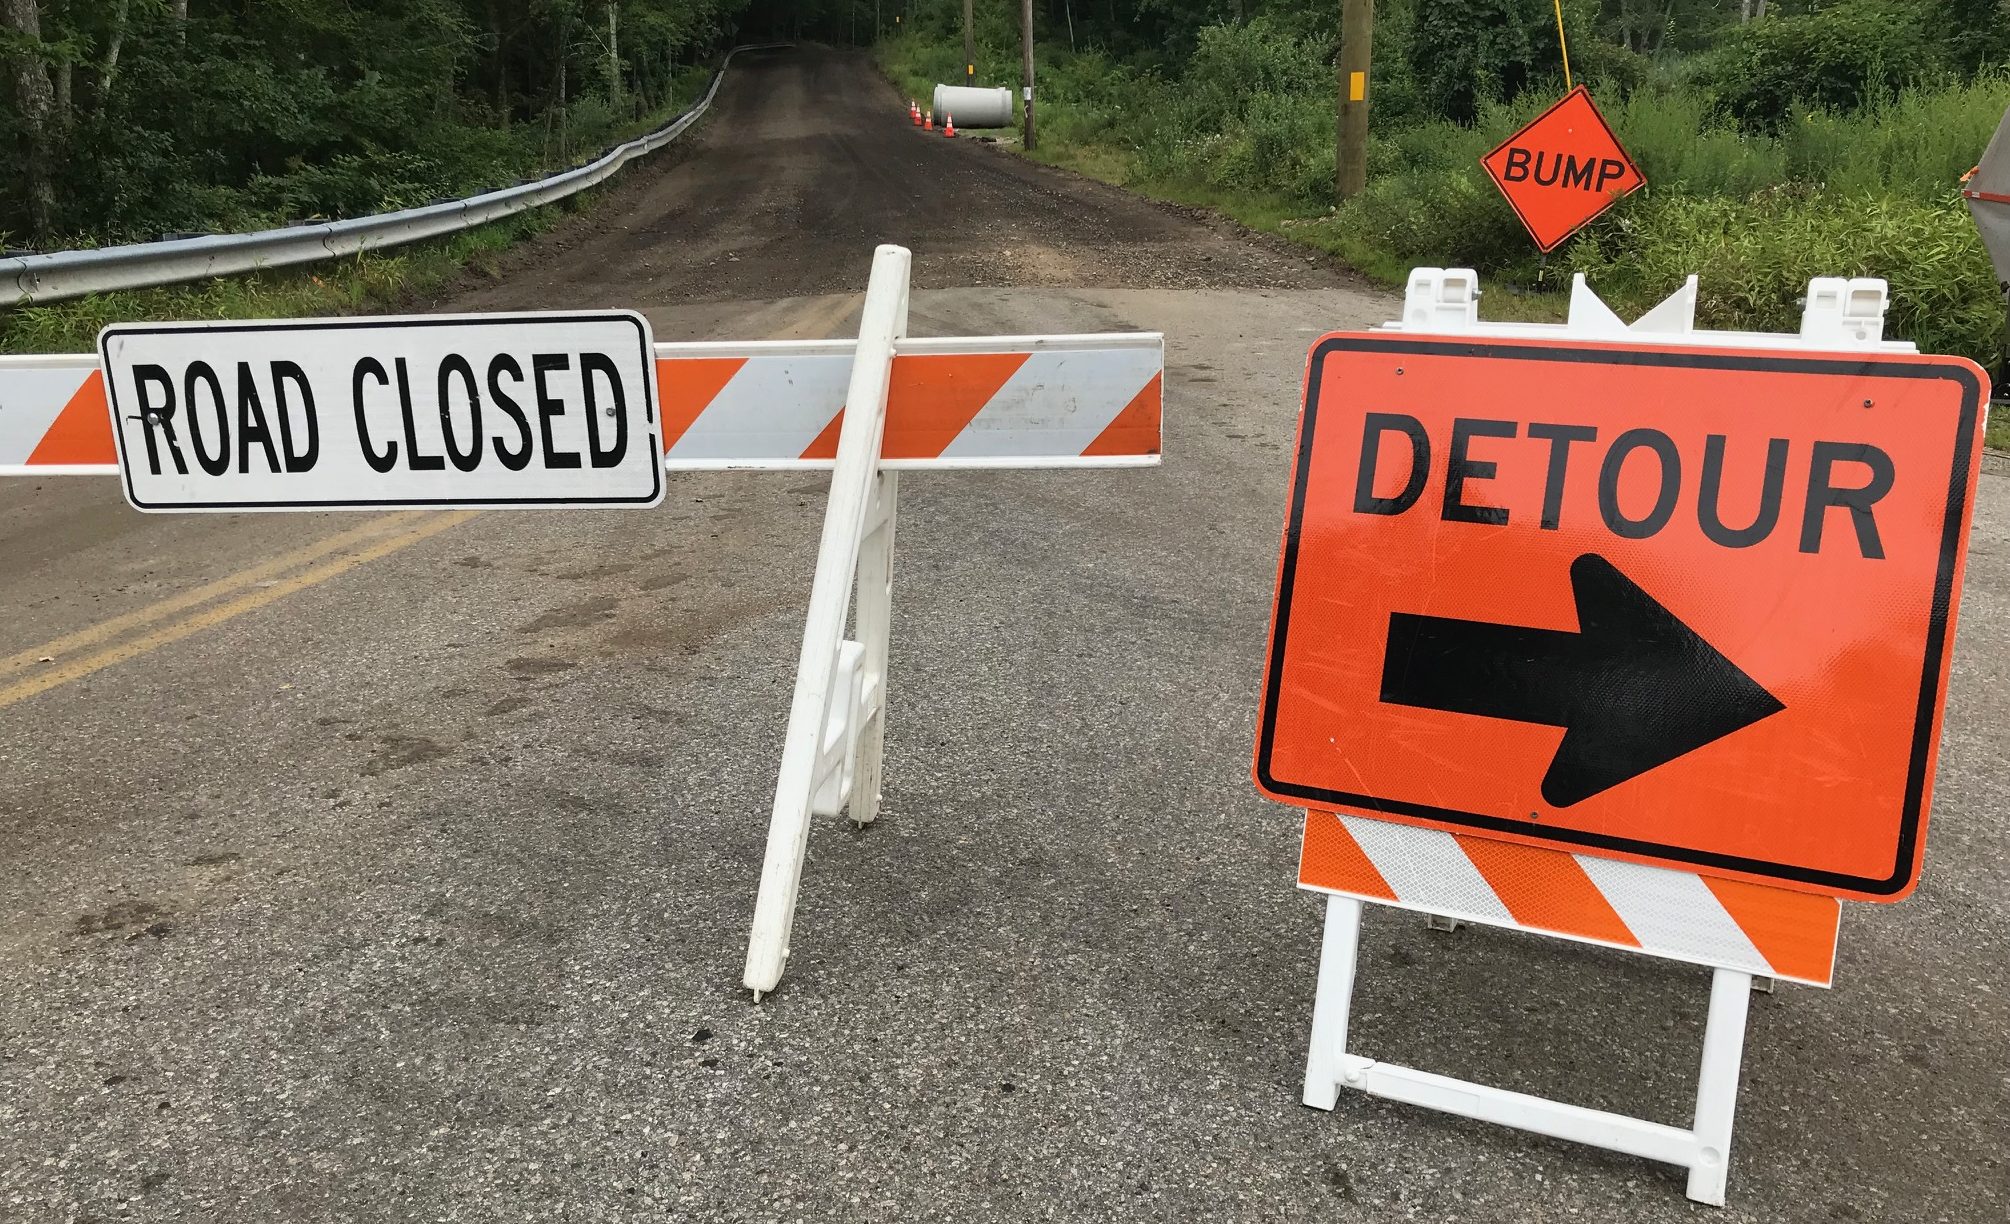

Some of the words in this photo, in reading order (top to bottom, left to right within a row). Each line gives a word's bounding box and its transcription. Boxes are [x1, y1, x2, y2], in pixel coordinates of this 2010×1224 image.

[1504, 147, 1625, 192] BUMP
[132, 360, 319, 476] ROAD
[352, 352, 628, 472] CLOSED
[1353, 412, 1896, 559] DETOUR
